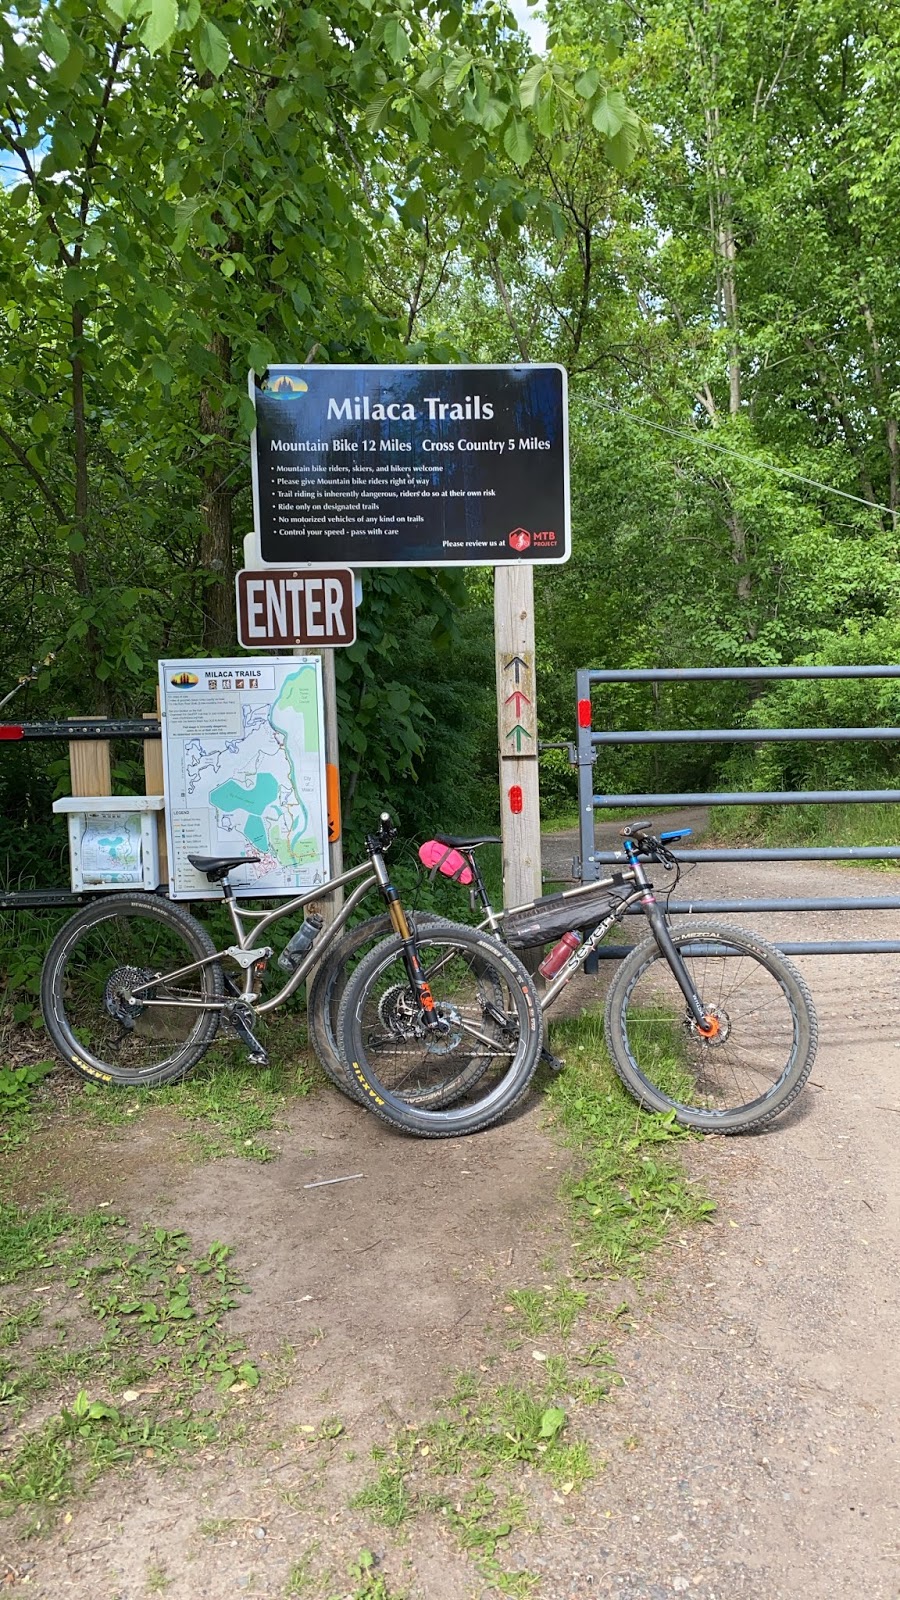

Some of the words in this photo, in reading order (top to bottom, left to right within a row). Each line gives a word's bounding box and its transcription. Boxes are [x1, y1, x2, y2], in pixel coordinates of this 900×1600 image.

[327, 396, 416, 420] Milaca
[424, 396, 494, 420] Trails
[270, 439, 328, 452] Mountain
[332, 439, 358, 452] Bike
[362, 440, 376, 452] 12
[380, 438, 412, 452] Miles
[422, 439, 454, 452] Cross
[457, 439, 505, 454] Country
[508, 439, 516, 451] 5
[518, 437, 550, 450] Miles
[328, 464, 350, 473] riders,
[352, 464, 374, 473] skiers,
[301, 478, 316, 486] give
[390, 478, 406, 486] right
[294, 490, 316, 500] riding
[324, 490, 360, 499] inherently
[361, 490, 398, 499] dangerous,
[295, 503, 311, 512] only
[323, 503, 360, 512] designated
[324, 528, 345, 537] speed
[534, 532, 555, 540] MTB
[246, 578, 346, 638] ENTER
[692, 994, 705, 1019] WHISKY
[72, 1056, 112, 1081] MAXXIS
[352, 1062, 384, 1106] MAXXIS
[404, 1090, 442, 1104] MEZCAL
